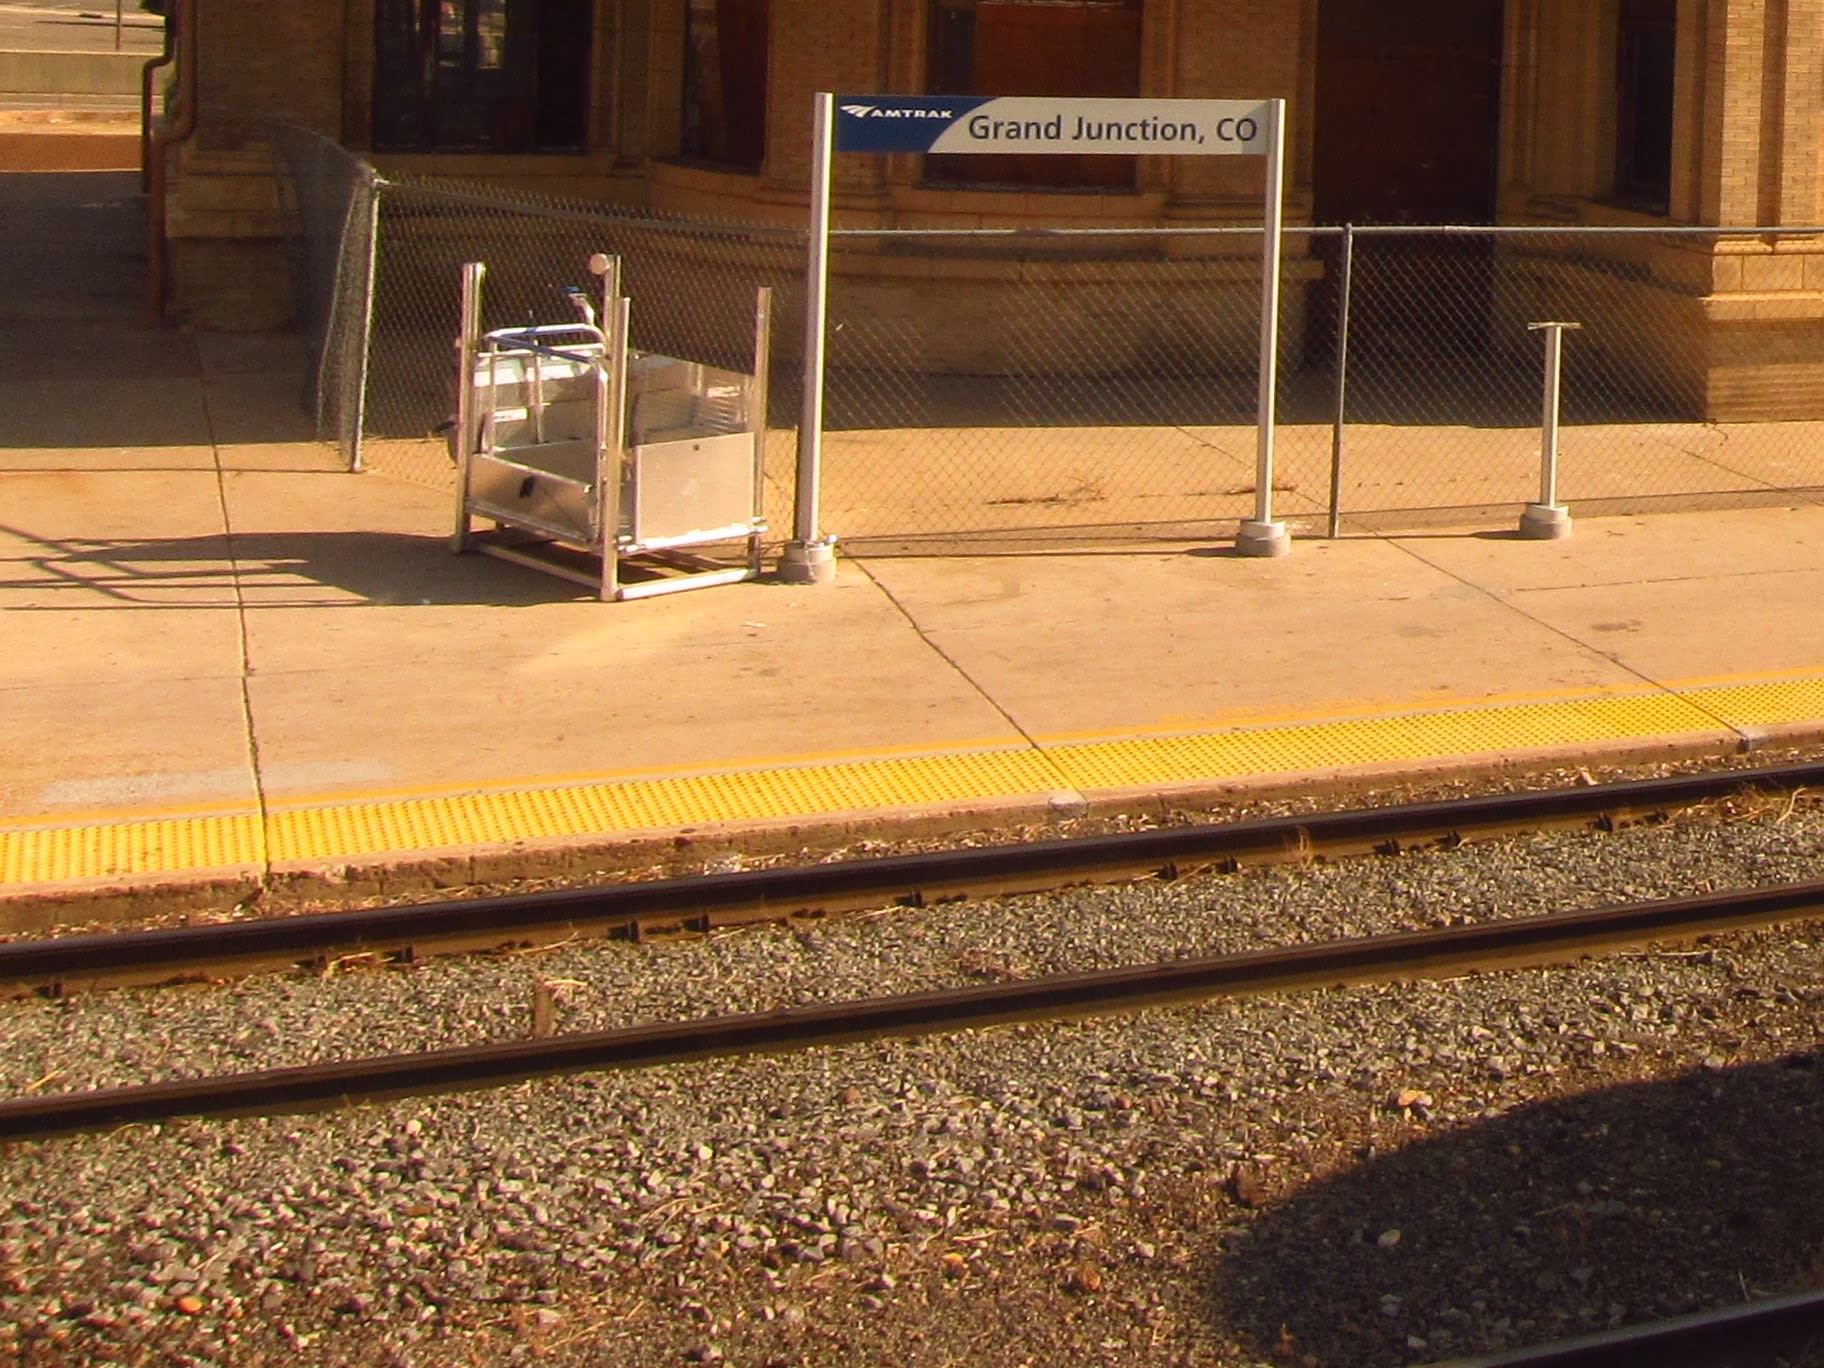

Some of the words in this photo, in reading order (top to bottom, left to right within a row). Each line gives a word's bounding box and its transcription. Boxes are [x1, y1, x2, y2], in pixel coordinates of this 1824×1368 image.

[870, 108, 953, 120] AMTRAK
[968, 114, 1061, 141] Grand
[1071, 116, 1206, 145] Junction,
[1215, 117, 1258, 142] CO
